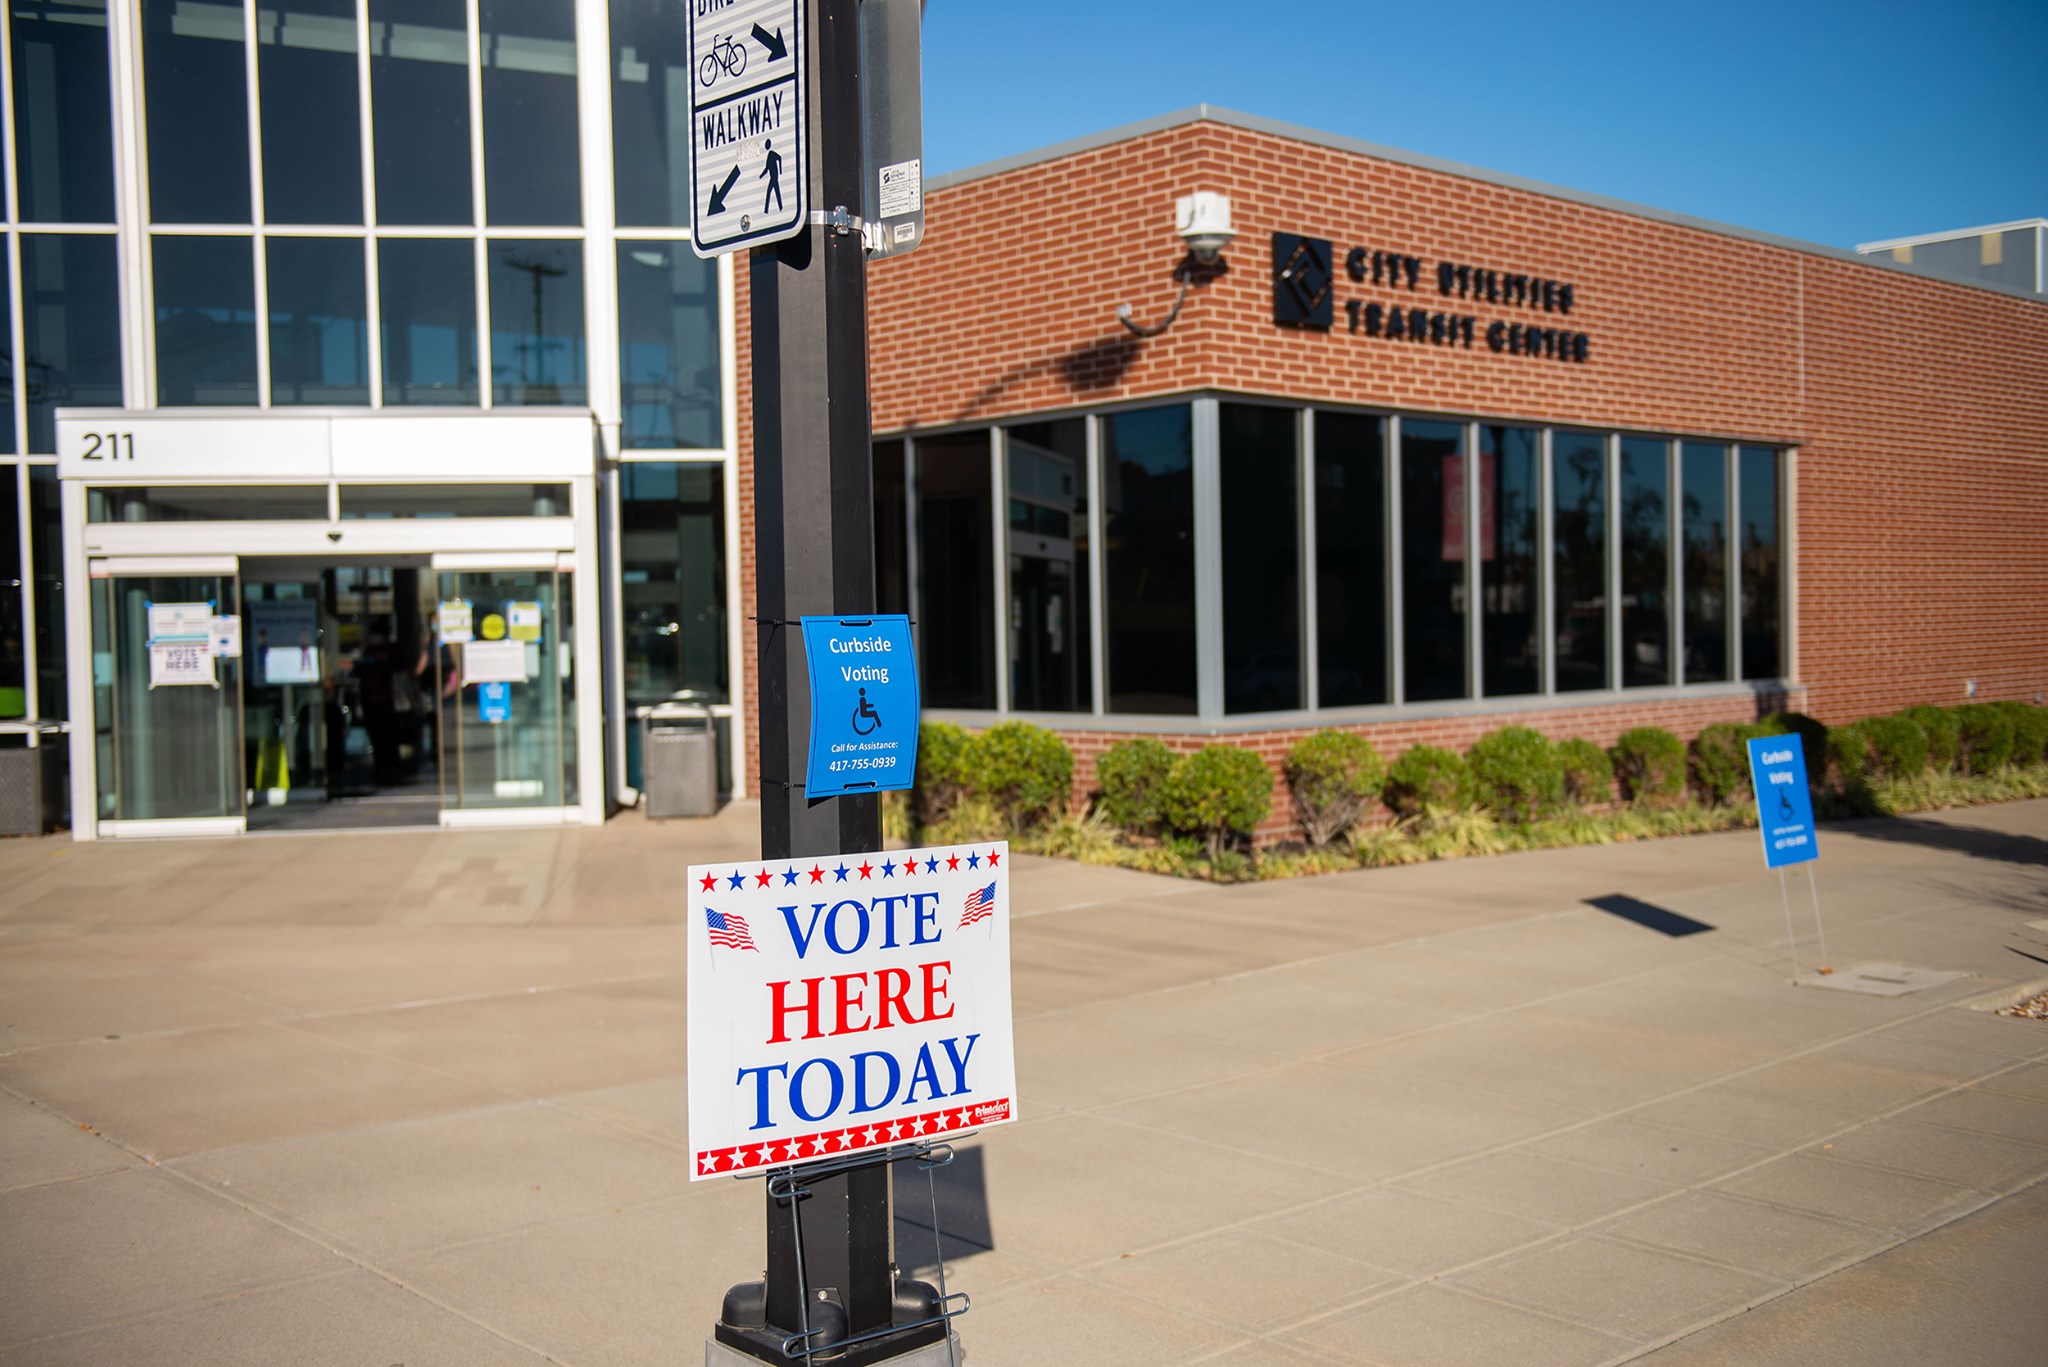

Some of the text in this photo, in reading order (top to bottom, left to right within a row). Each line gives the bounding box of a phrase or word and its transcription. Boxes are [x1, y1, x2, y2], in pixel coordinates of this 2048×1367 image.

[703, 90, 783, 150] WALKWAY
[1346, 247, 1574, 314] CITY UTILITIES
[1345, 300, 1588, 363] TRANSIT CENTER
[82, 432, 134, 460] 211
[166, 647, 198, 658] VOTE
[829, 636, 892, 653] Curbside
[841, 665, 889, 684] Voting
[829, 756, 896, 772] 417-755-0939
[831, 741, 899, 753] Call for Assistance:
[777, 891, 942, 959] VOTE
[766, 960, 955, 1045] HERE
[736, 1033, 981, 1130] TODAY
